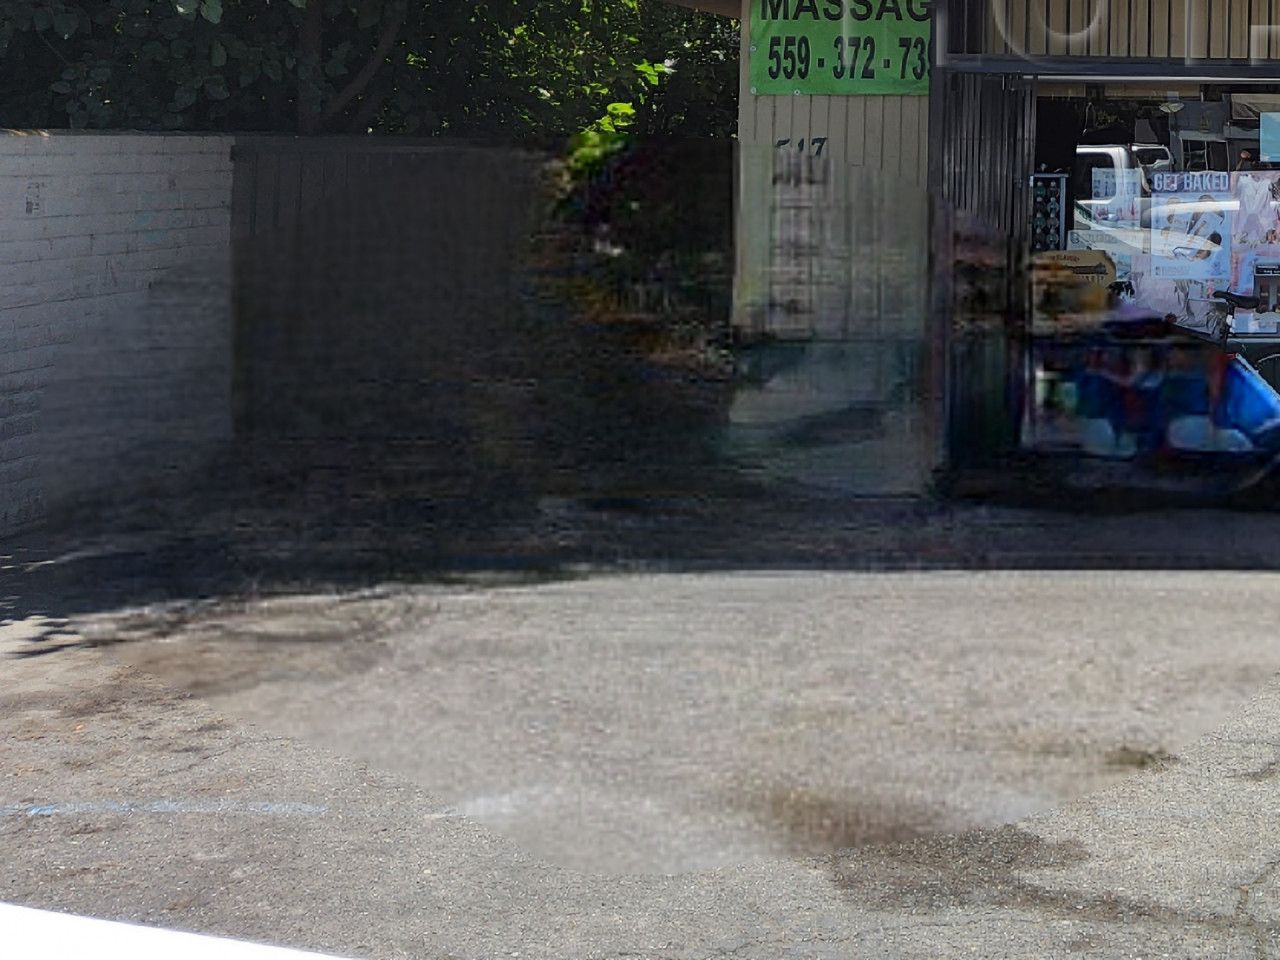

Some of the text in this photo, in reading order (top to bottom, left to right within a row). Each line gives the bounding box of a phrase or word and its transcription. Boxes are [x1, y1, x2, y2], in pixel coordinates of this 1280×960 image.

[768, 35, 811, 80] 559
[833, 36, 875, 80] 372
[1153, 172, 1229, 191] GET BAKED
